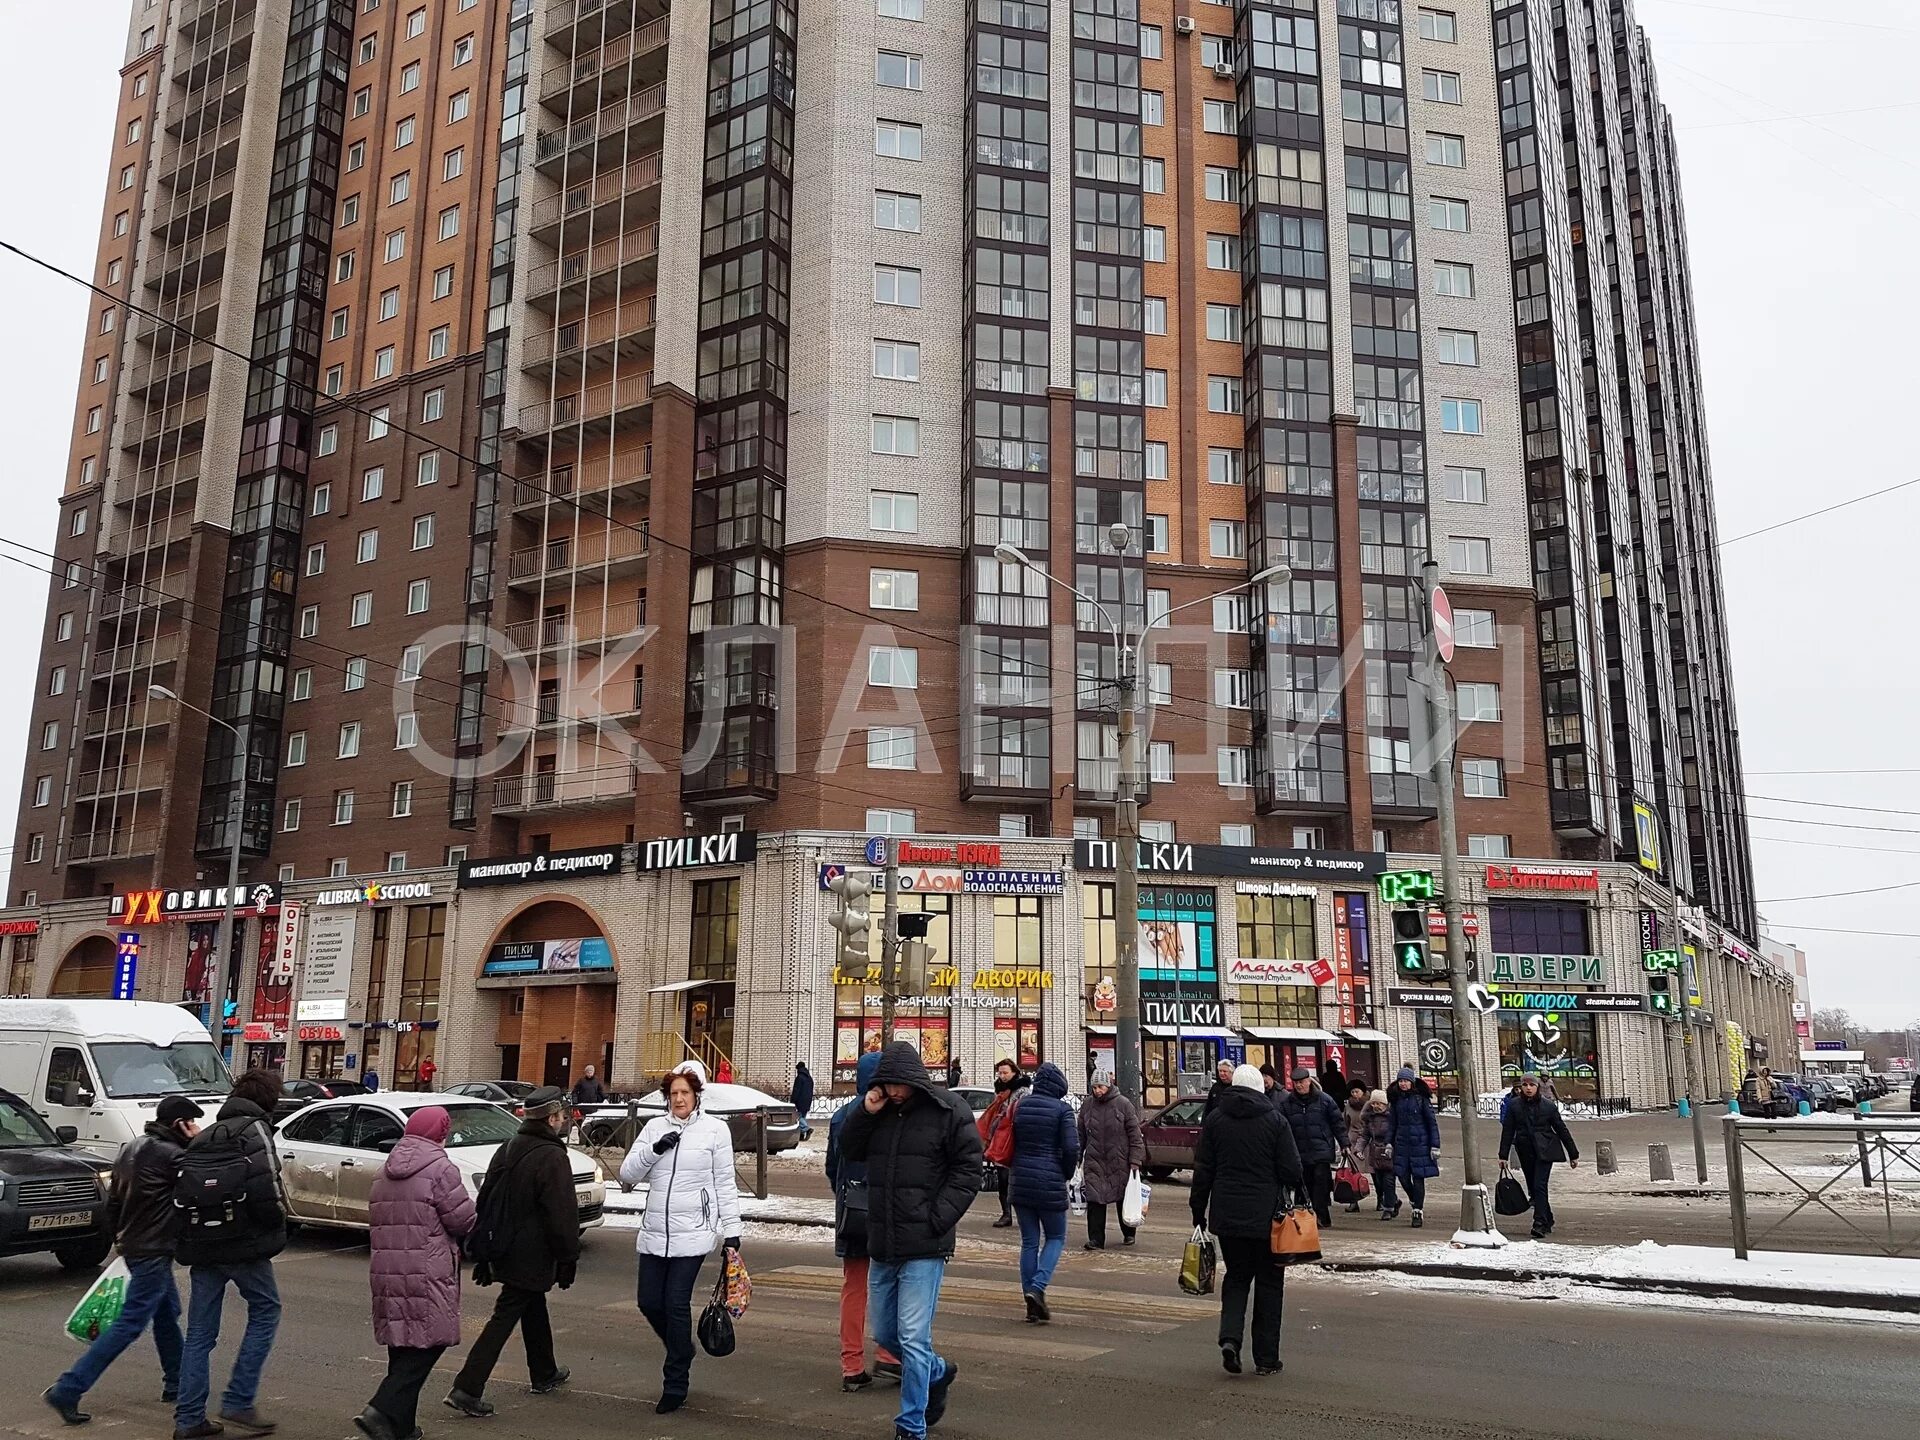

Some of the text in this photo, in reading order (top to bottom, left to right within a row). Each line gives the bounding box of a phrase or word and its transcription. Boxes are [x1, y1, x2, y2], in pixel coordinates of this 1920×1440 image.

[898, 840, 951, 863] Двери
[469, 853, 613, 879] маникюр & педикюр
[1250, 856, 1364, 871] маникюр & педикюр
[965, 871, 1063, 884] ОТОПЛЕНИЕ
[1561, 869, 1593, 877] КРОВАТИ
[964, 882, 1064, 894] ВОДОСНАБЖЕНИЕ
[1236, 881, 1271, 897] Шторы
[1383, 874, 1431, 901] 0:24
[1510, 875, 1598, 890] ОПТИМУМ
[316, 883, 432, 905] ALIBRA SCHOOL
[281, 909, 297, 973] ОБУВЬ
[1337, 907, 1348, 969] РУССКАЯ
[1230, 960, 1306, 981] Мария
[1493, 956, 1602, 982] ДВЕРИ
[972, 969, 1053, 989] ДВОРИК
[962, 997, 1016, 1008] ПЕКАРНЯ
[1400, 994, 1423, 1002] кухня
[1502, 992, 1578, 1013] напарах
[1586, 997, 1615, 1005] steamed
[300, 1026, 340, 1040] ОБУВЬ
